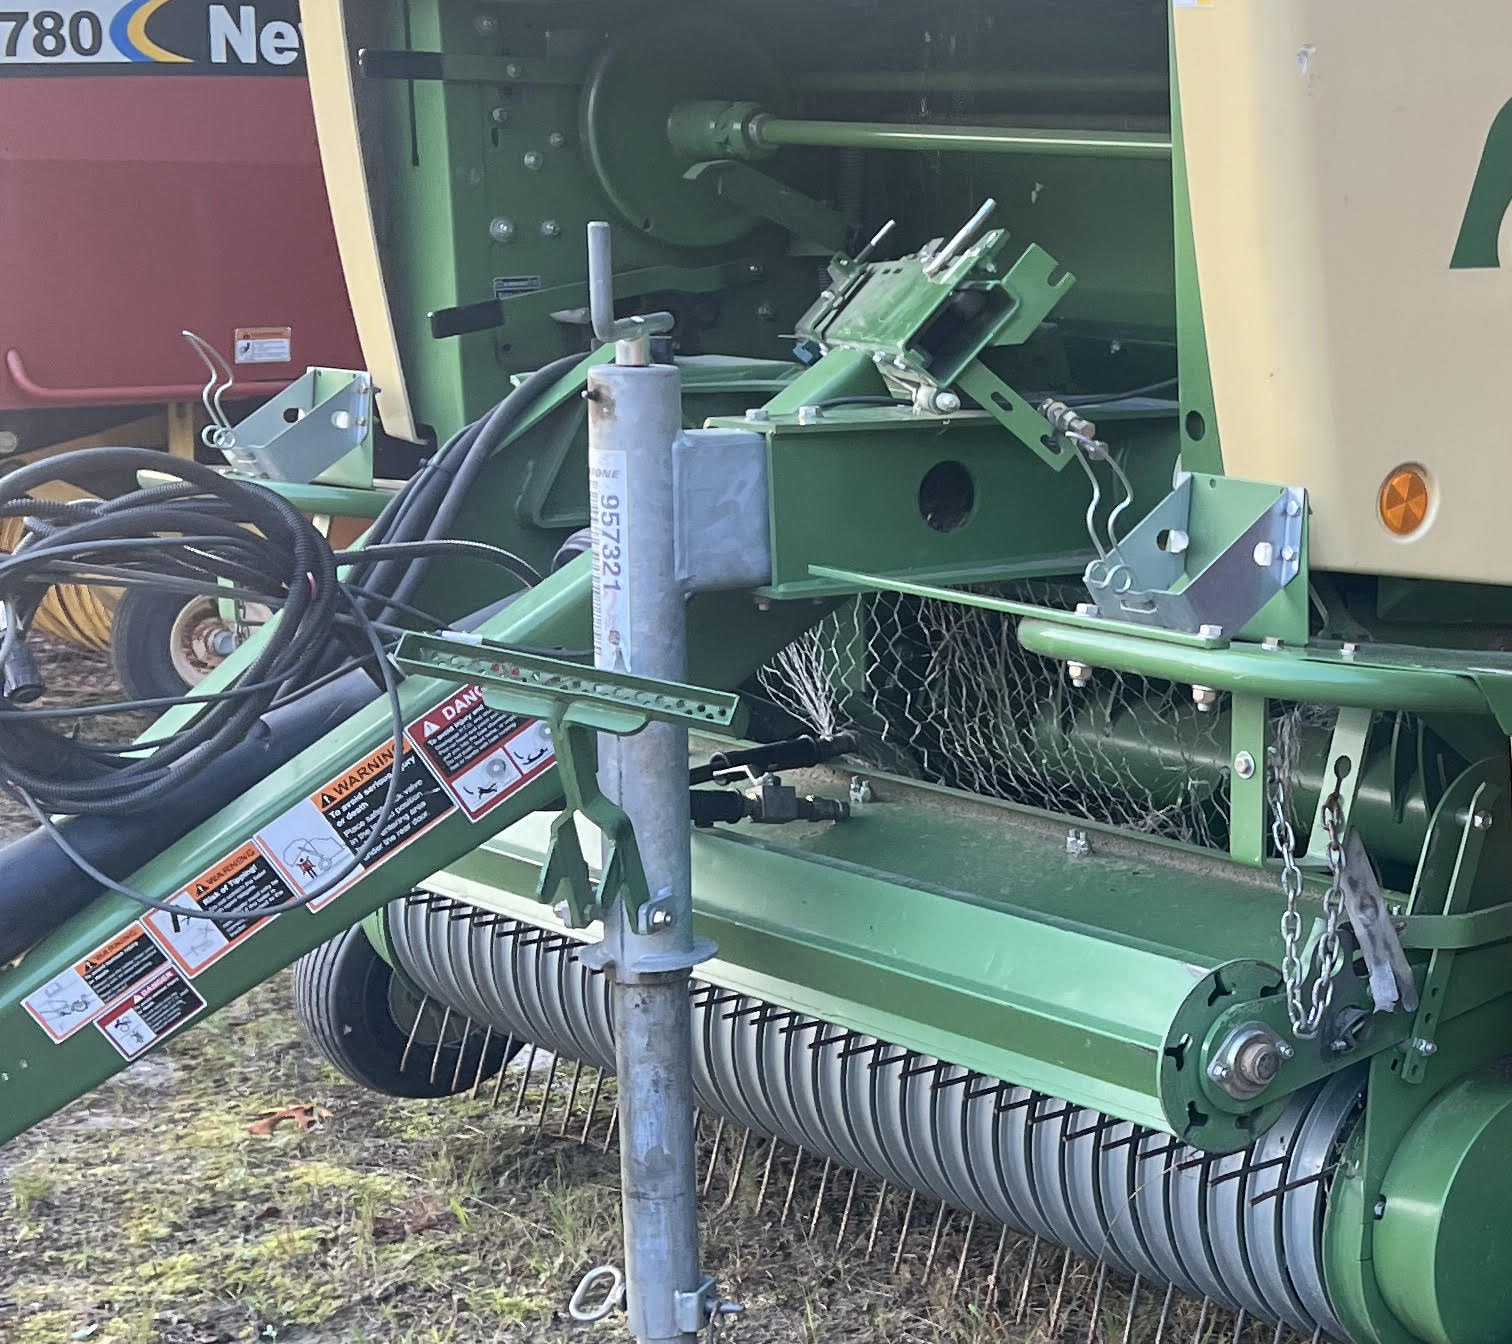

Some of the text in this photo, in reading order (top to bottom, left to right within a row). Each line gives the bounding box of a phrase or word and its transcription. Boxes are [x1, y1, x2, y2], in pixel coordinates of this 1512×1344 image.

[0, 10, 103, 57] 780
[208, 4, 307, 66] Ne
[602, 494, 622, 592] 957321
[332, 739, 406, 798] WARNIN
[327, 807, 342, 821] To
[339, 791, 364, 812] avoid
[334, 800, 369, 828] or death
[357, 827, 372, 841] the
[382, 832, 398, 847] the
[205, 846, 256, 886] WARNING
[218, 883, 230, 894] of
